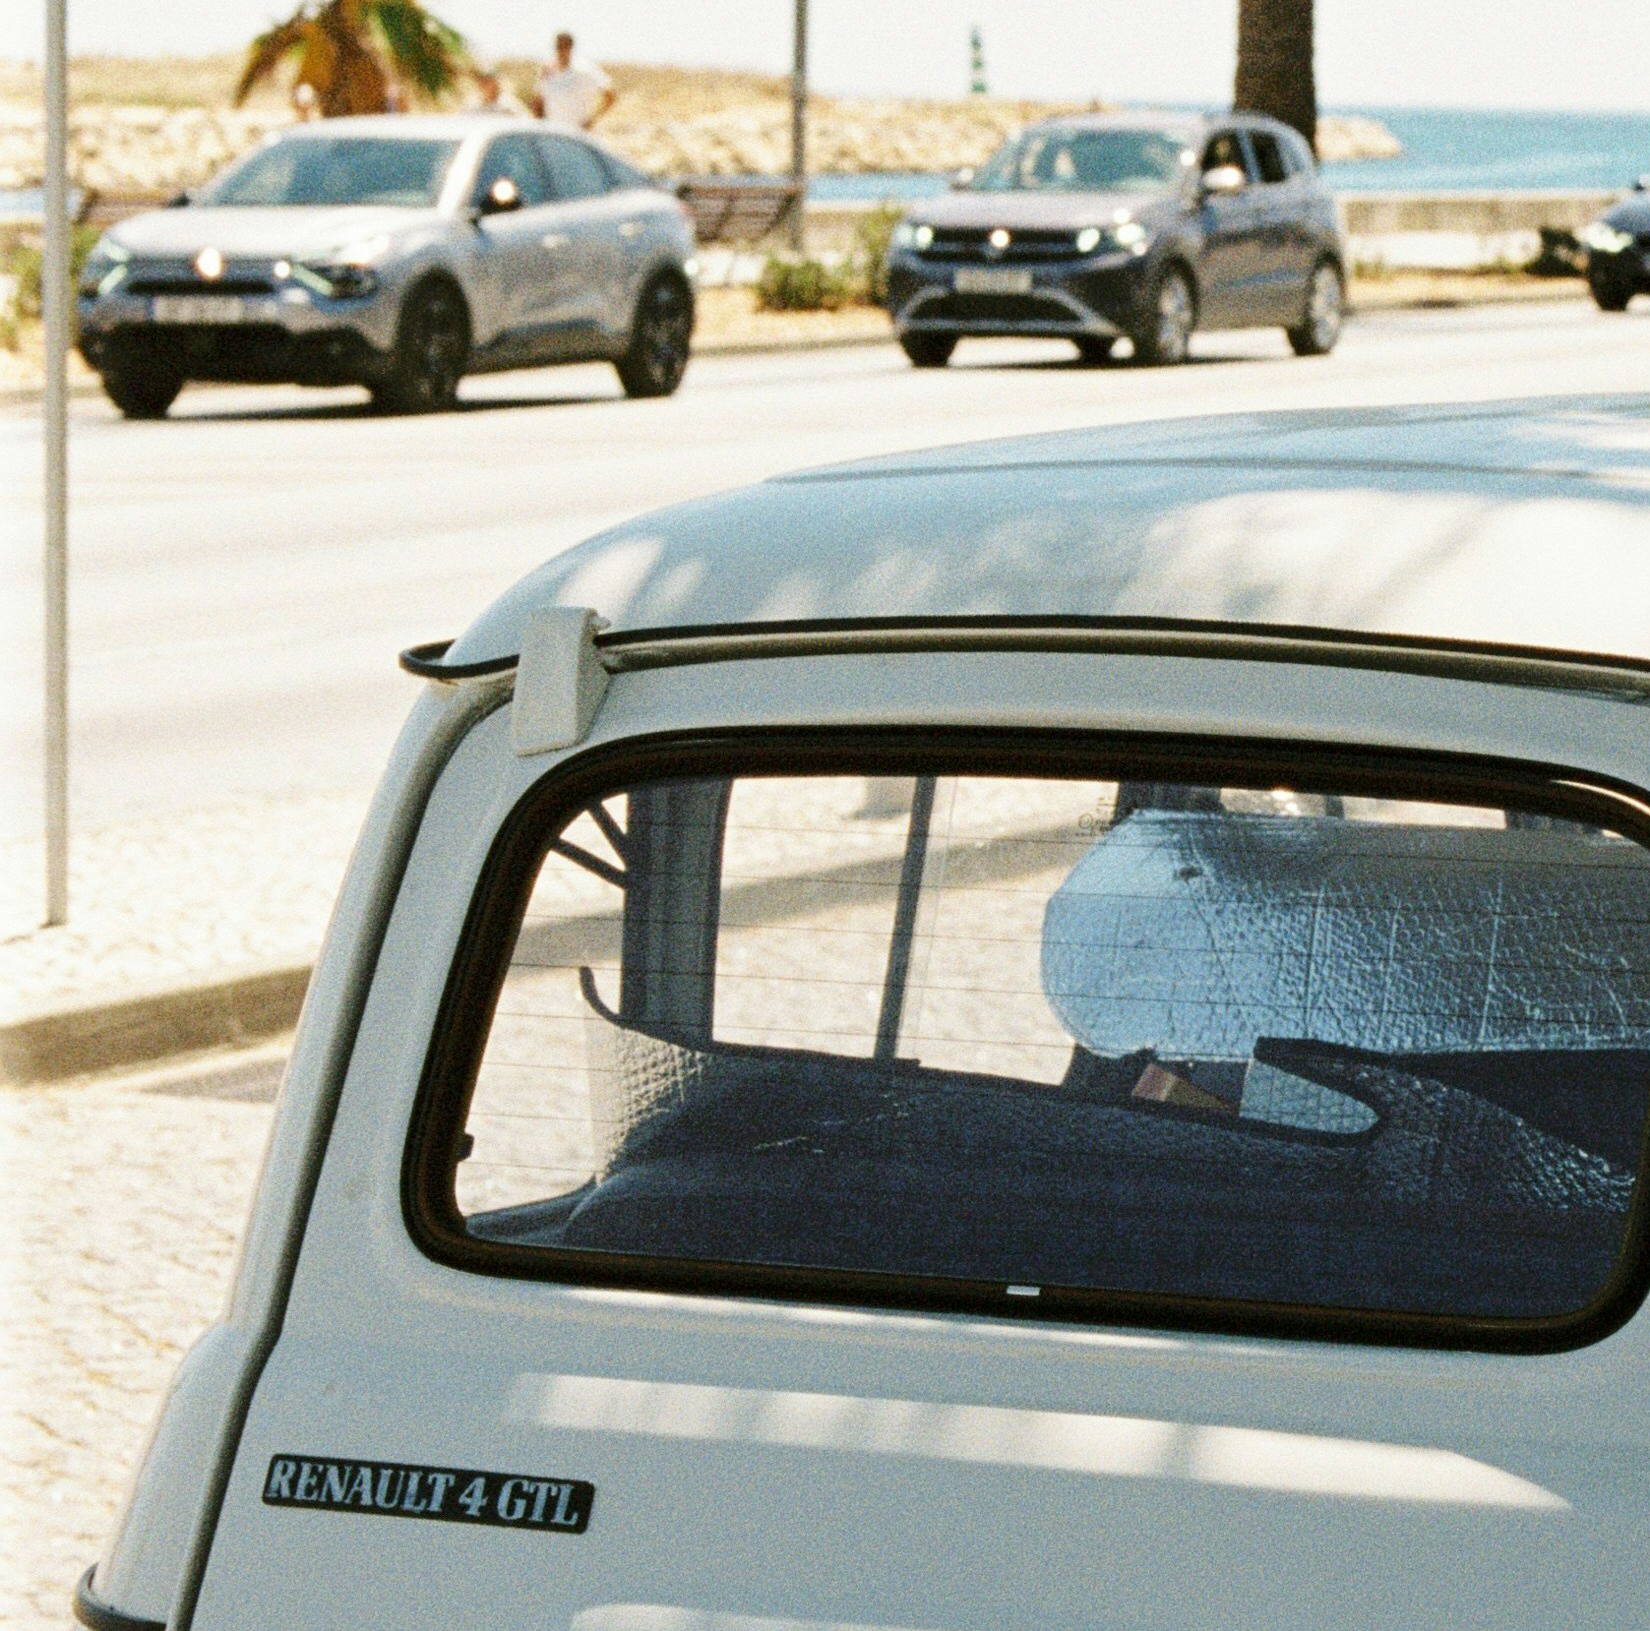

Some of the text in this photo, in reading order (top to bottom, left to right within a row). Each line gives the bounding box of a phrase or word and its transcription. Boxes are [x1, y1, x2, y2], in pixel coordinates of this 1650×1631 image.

[266, 1459, 580, 1527] RENAULT 4 GTL
